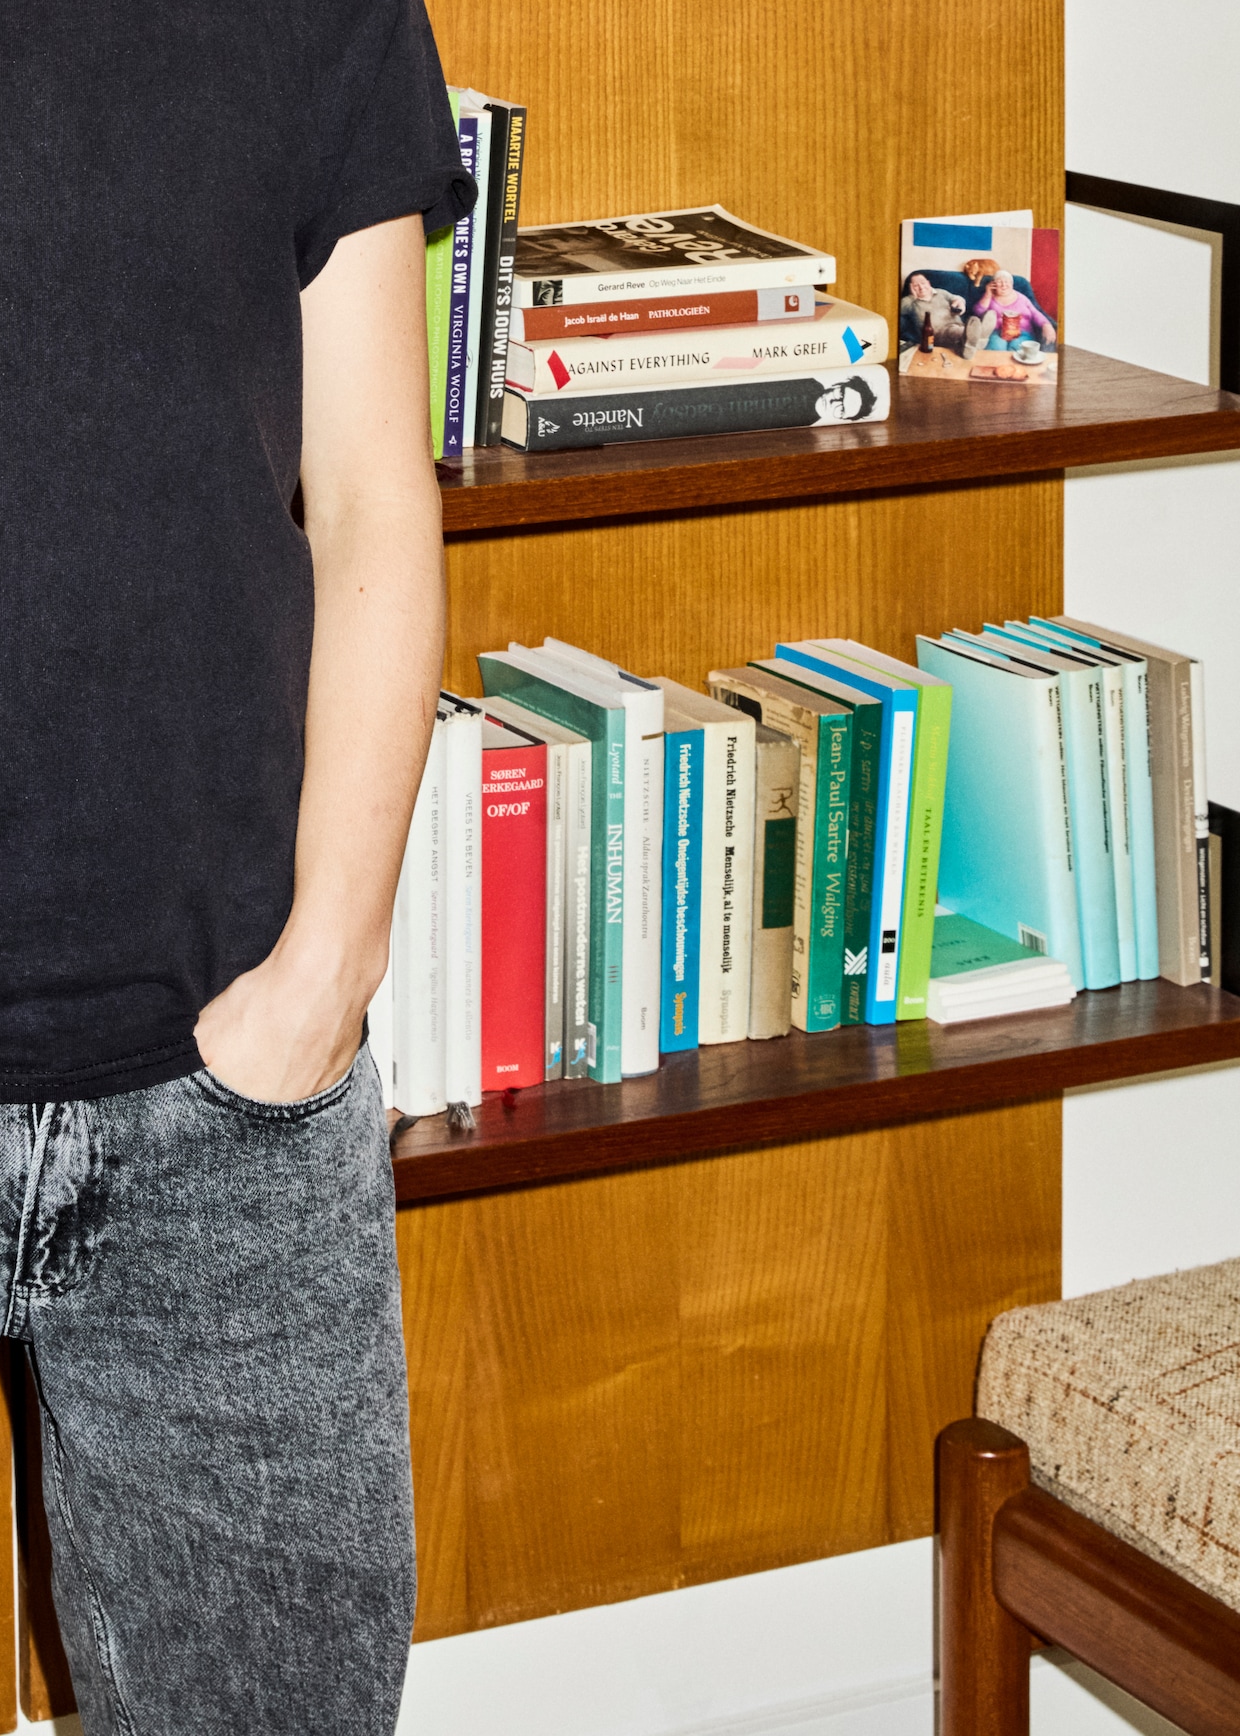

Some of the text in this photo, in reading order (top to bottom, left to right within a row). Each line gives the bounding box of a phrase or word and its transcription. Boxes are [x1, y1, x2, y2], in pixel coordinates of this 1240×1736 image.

[504, 115, 523, 224] MAARTJE WORTEL
[597, 280, 645, 292] Gerard Reve
[565, 316, 585, 327] Jacob
[609, 313, 618, 322] de
[620, 312, 639, 321] Haan
[752, 341, 828, 360] MARK GREIF
[567, 350, 711, 376] AGAINST EVERYTHING
[573, 407, 644, 427] Nanette
[490, 768, 526, 780] SØREN
[487, 802, 530, 817] OF/OF
[820, 725, 847, 937] Jean-Paul Sartre Walging
[608, 823, 623, 924] INHUMAN
[496, 1064, 519, 1074] BOOM
